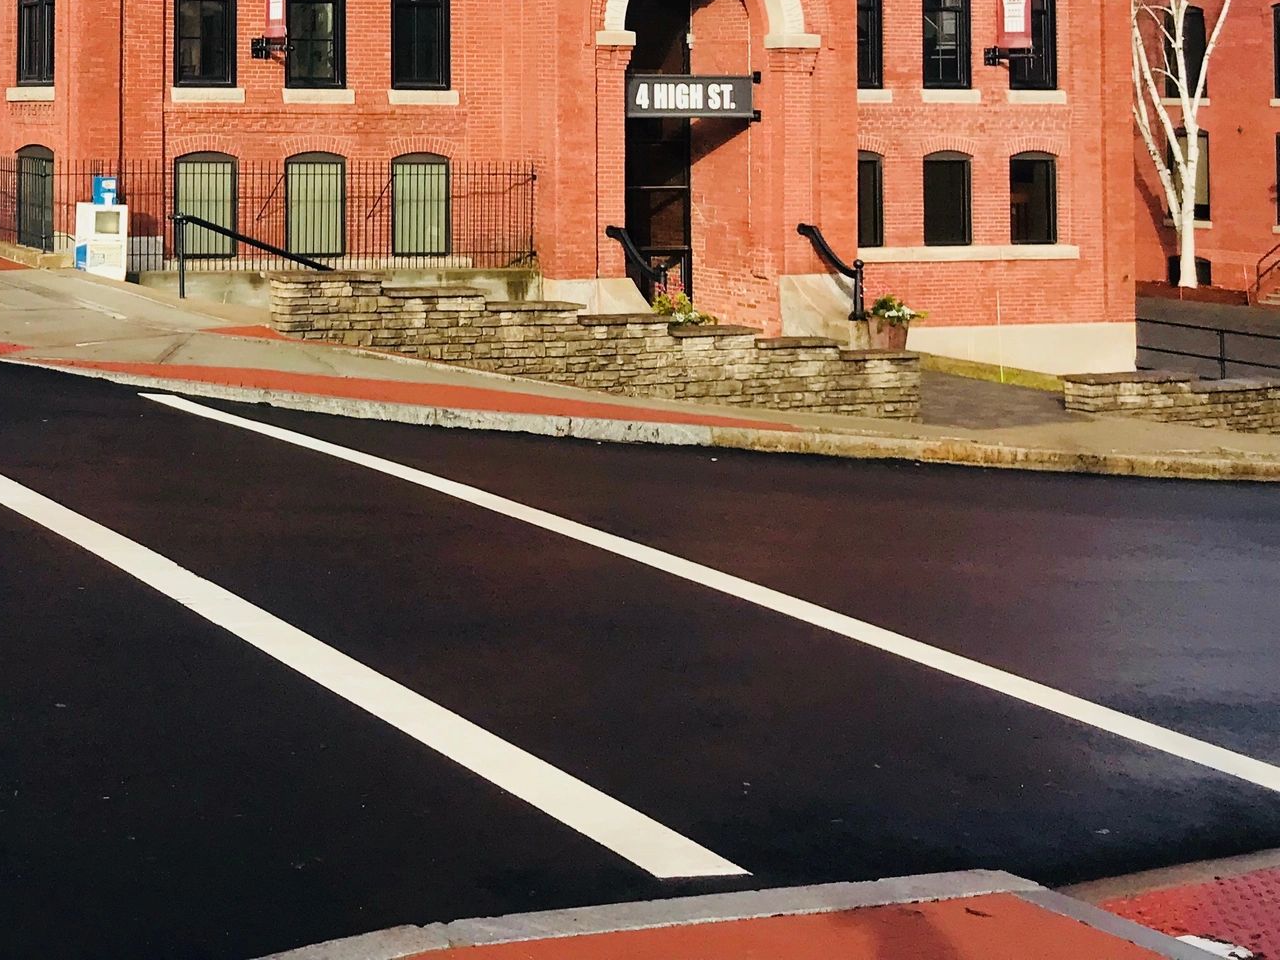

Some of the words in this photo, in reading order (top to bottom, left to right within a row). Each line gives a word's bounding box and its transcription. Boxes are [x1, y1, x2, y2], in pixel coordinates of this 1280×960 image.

[635, 83, 650, 109] 4
[654, 83, 703, 109] HIGH
[707, 83, 736, 109] ST.
